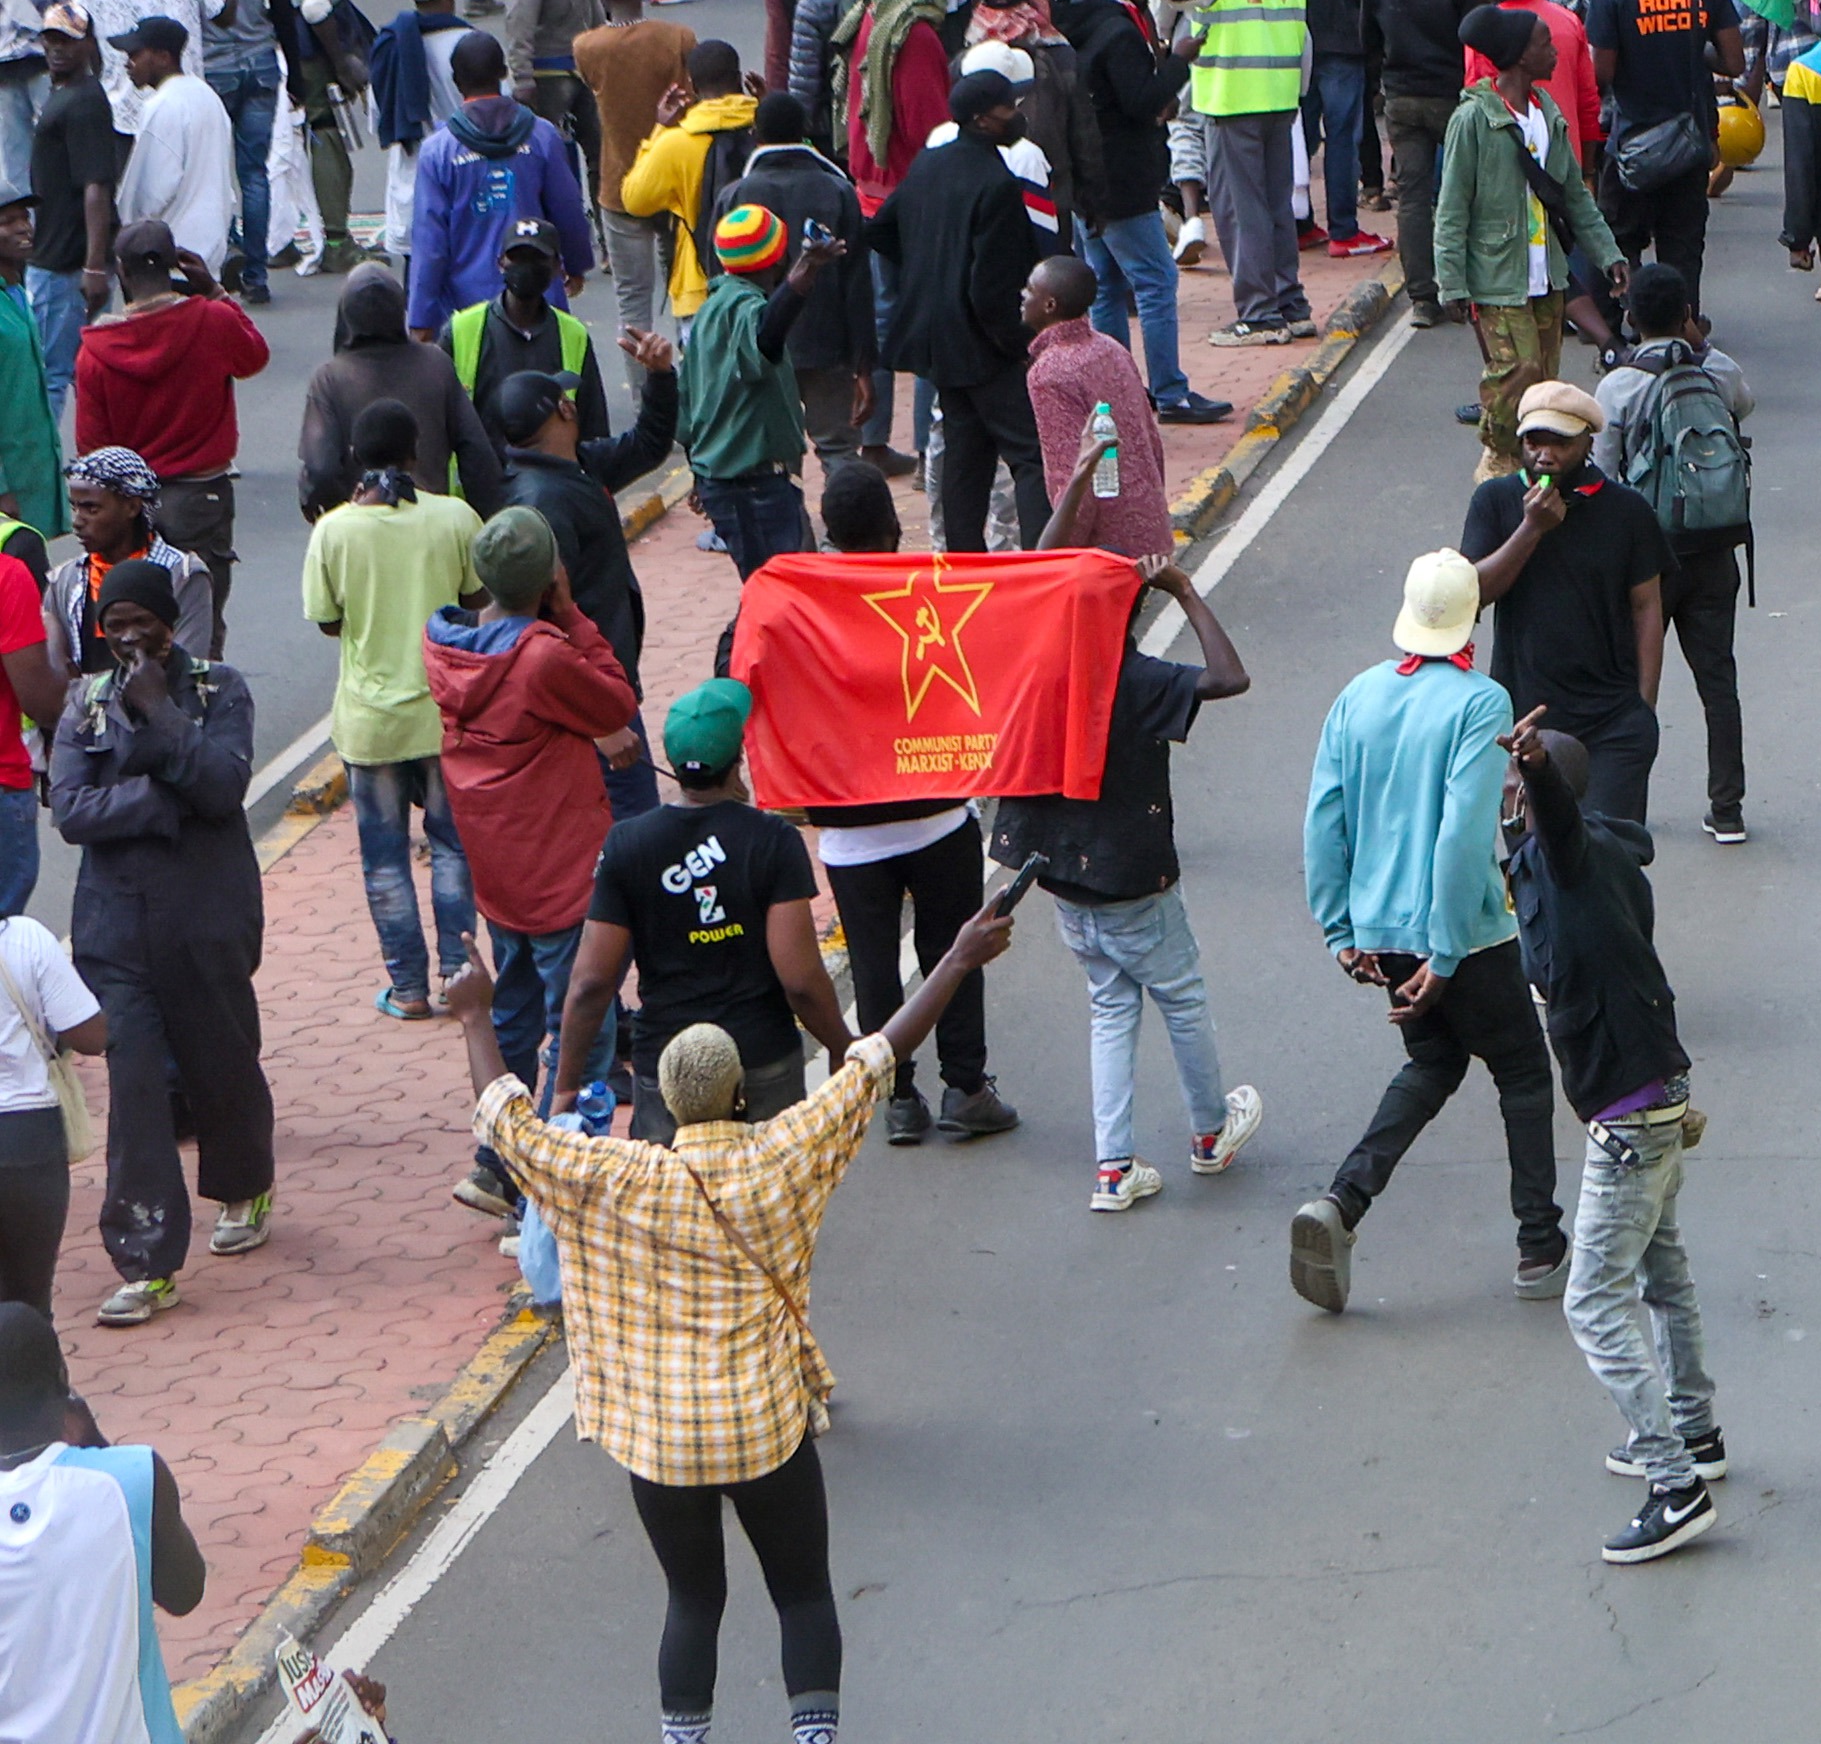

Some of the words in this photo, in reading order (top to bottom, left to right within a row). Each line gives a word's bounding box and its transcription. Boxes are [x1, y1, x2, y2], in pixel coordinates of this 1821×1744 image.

[893, 736, 962, 755] COMMUNIST
[964, 733, 999, 752] PARTY
[661, 835, 727, 895] GEN
[693, 885, 726, 924] Z
[688, 923, 744, 943] POWER
